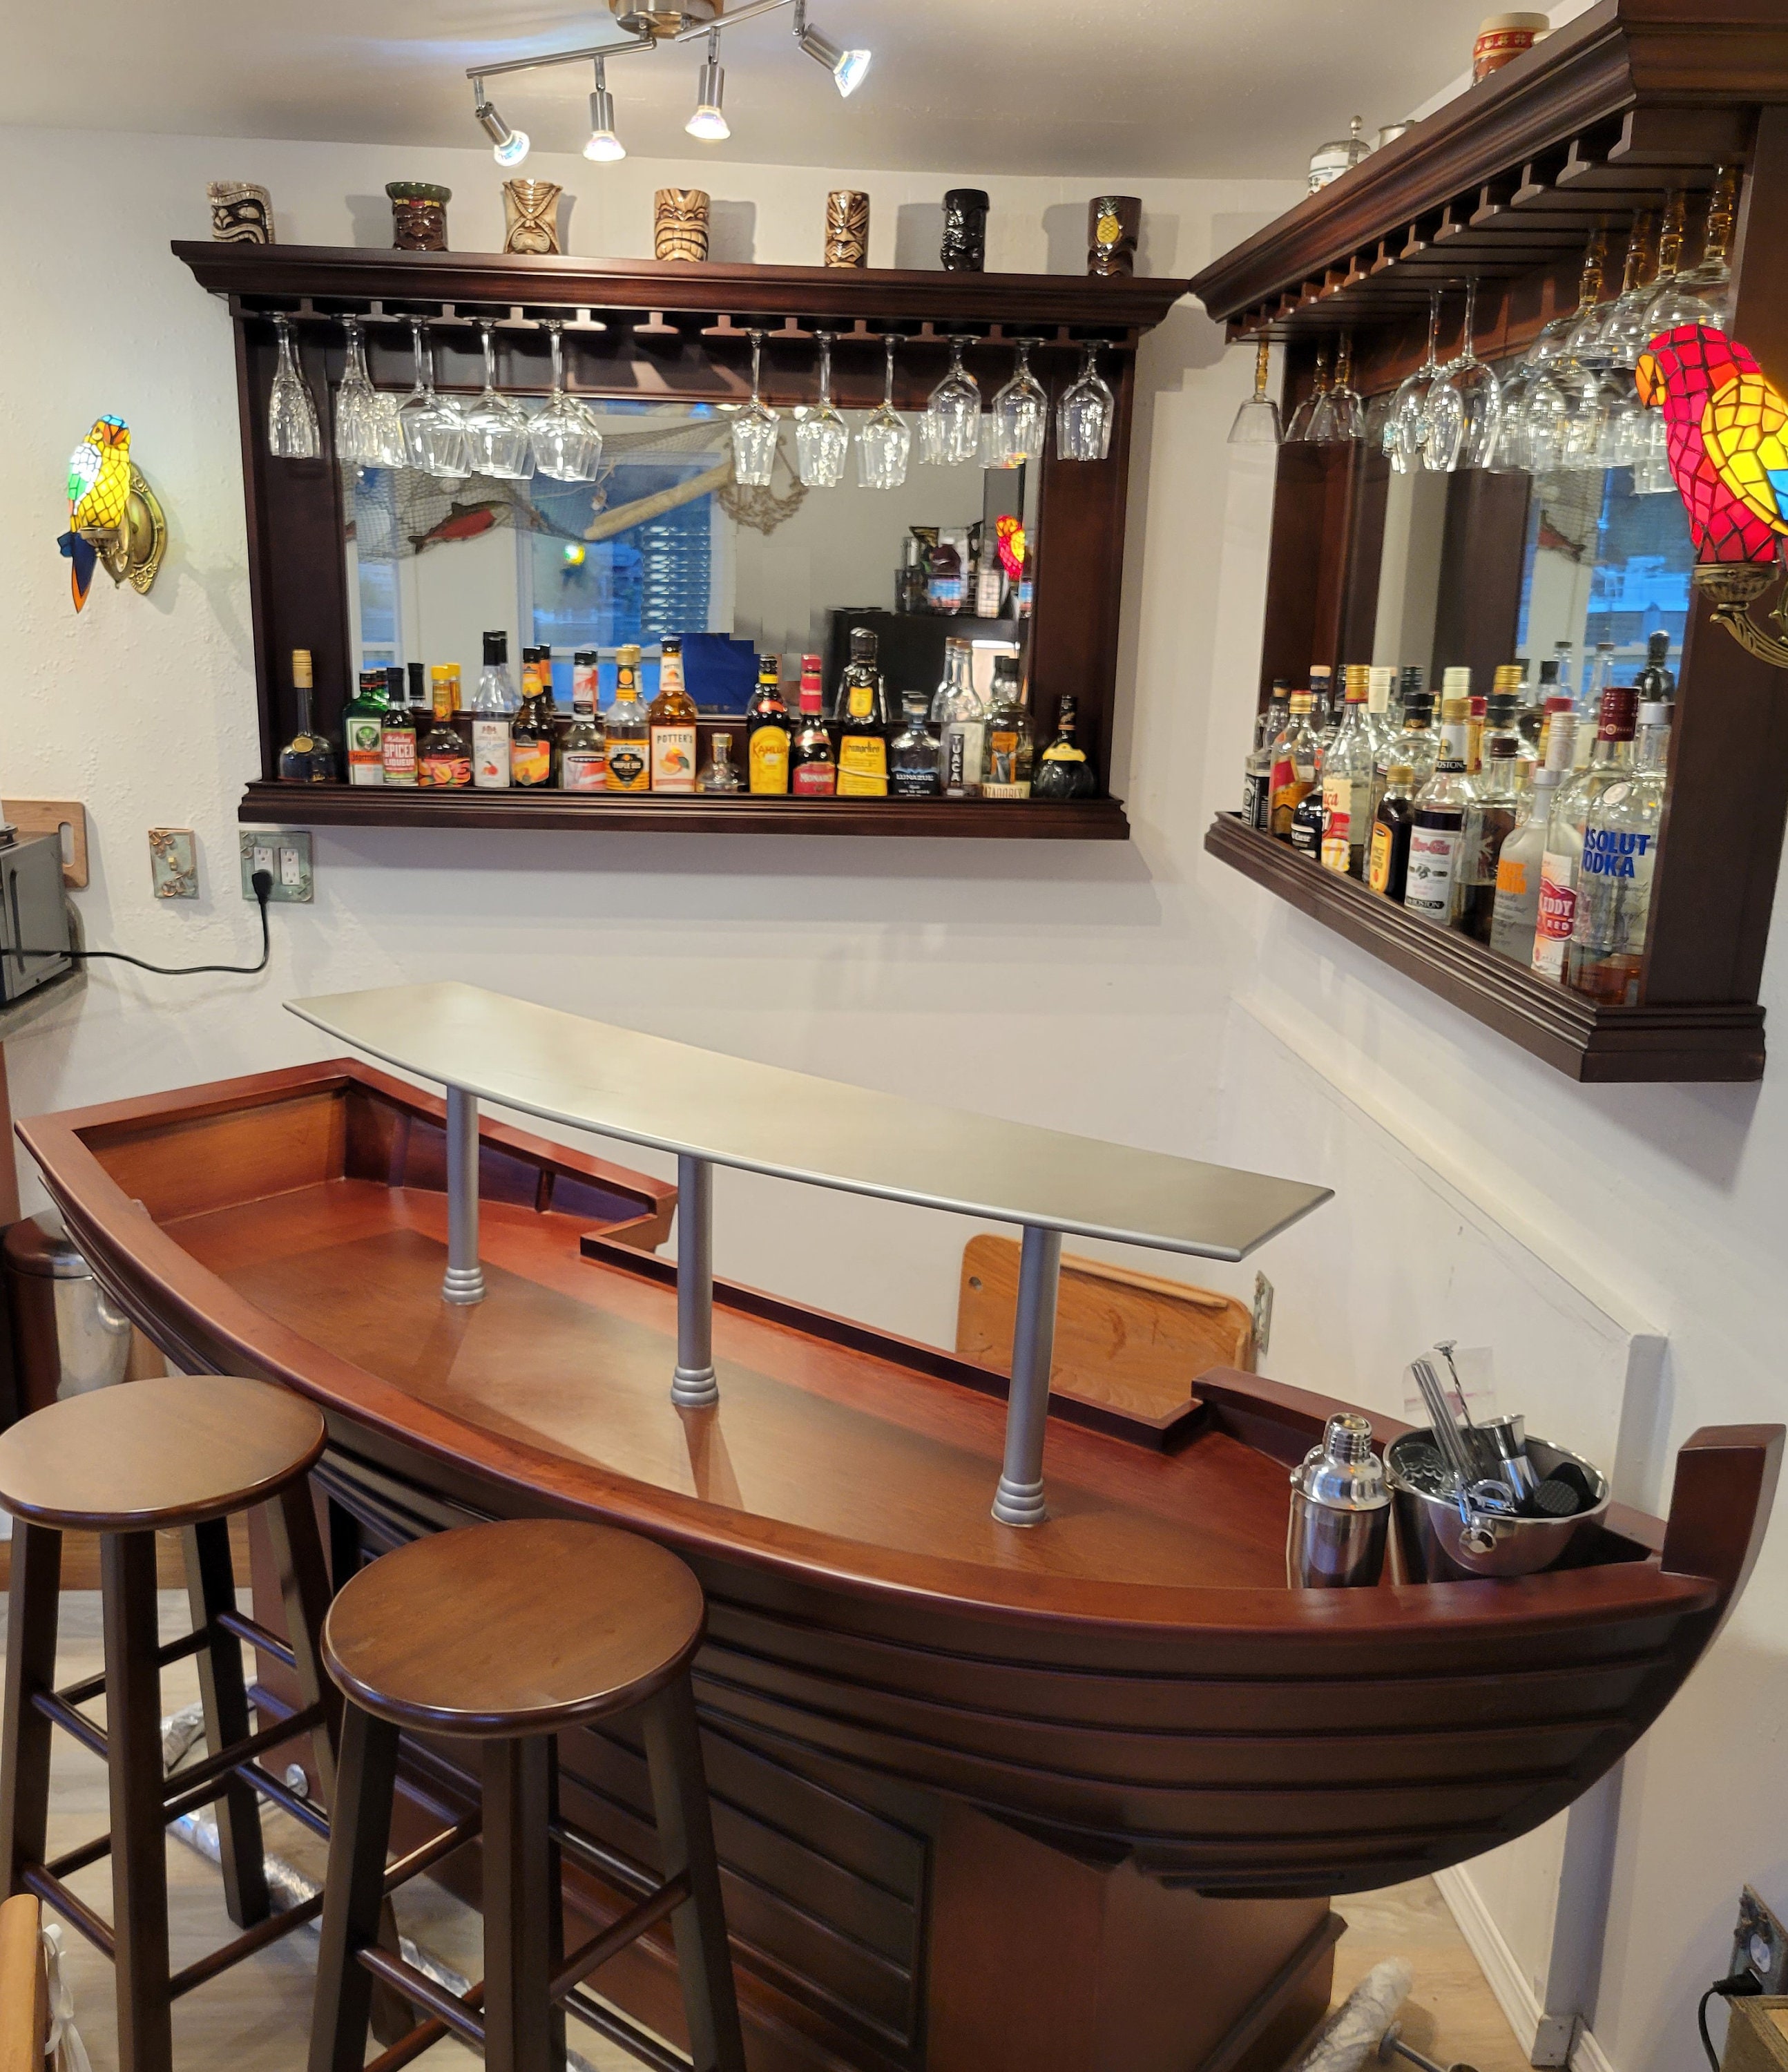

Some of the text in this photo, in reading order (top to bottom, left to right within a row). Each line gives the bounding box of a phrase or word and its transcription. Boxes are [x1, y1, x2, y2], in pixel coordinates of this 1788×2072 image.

[657, 734, 693, 744] POTTER'S
[384, 743, 414, 758] SPICED
[951, 735, 961, 782] TUACA
[1437, 760, 1464, 769] OSTON
[1583, 849, 1635, 879] ODKA
